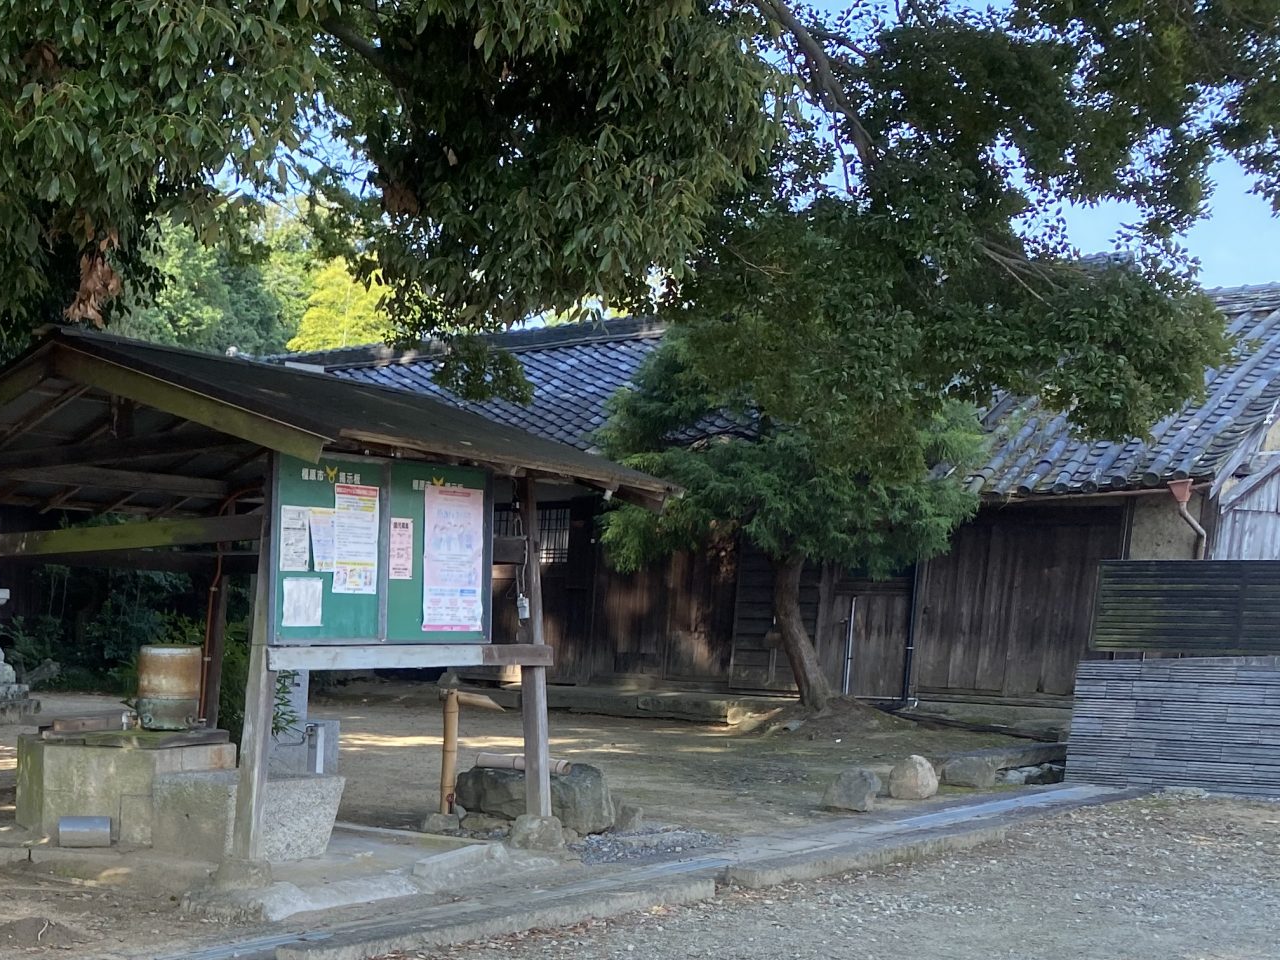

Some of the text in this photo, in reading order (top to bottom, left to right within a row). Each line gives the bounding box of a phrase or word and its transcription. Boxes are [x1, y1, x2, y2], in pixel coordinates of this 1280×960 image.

[301, 468, 361, 485] 橿原市 掲示板
